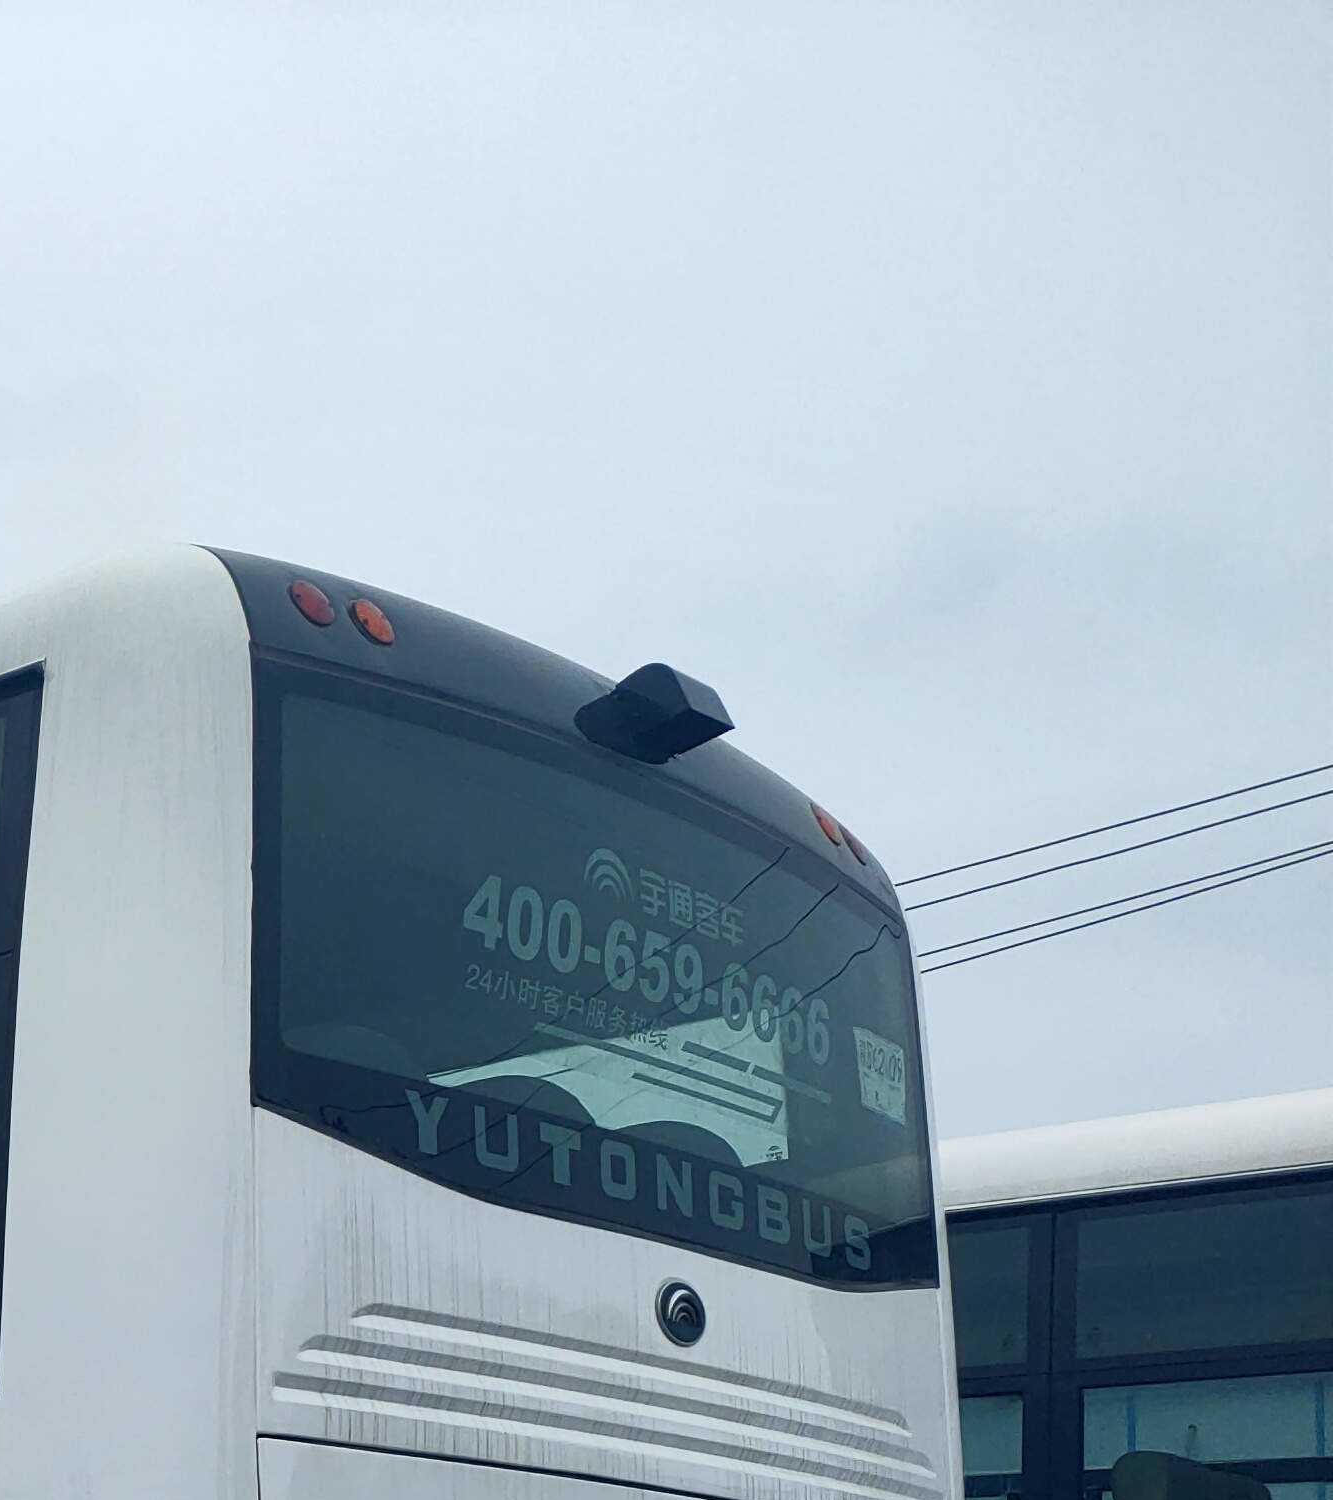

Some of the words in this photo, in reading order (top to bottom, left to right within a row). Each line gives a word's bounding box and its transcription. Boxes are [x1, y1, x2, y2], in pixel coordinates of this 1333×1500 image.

[463, 874, 830, 1065] 400-659-6666
[639, 868, 744, 945] 宇通客车
[464, 963, 669, 1051] 24小时客户服务热线
[405, 1088, 872, 1272] YUTONGBUS
